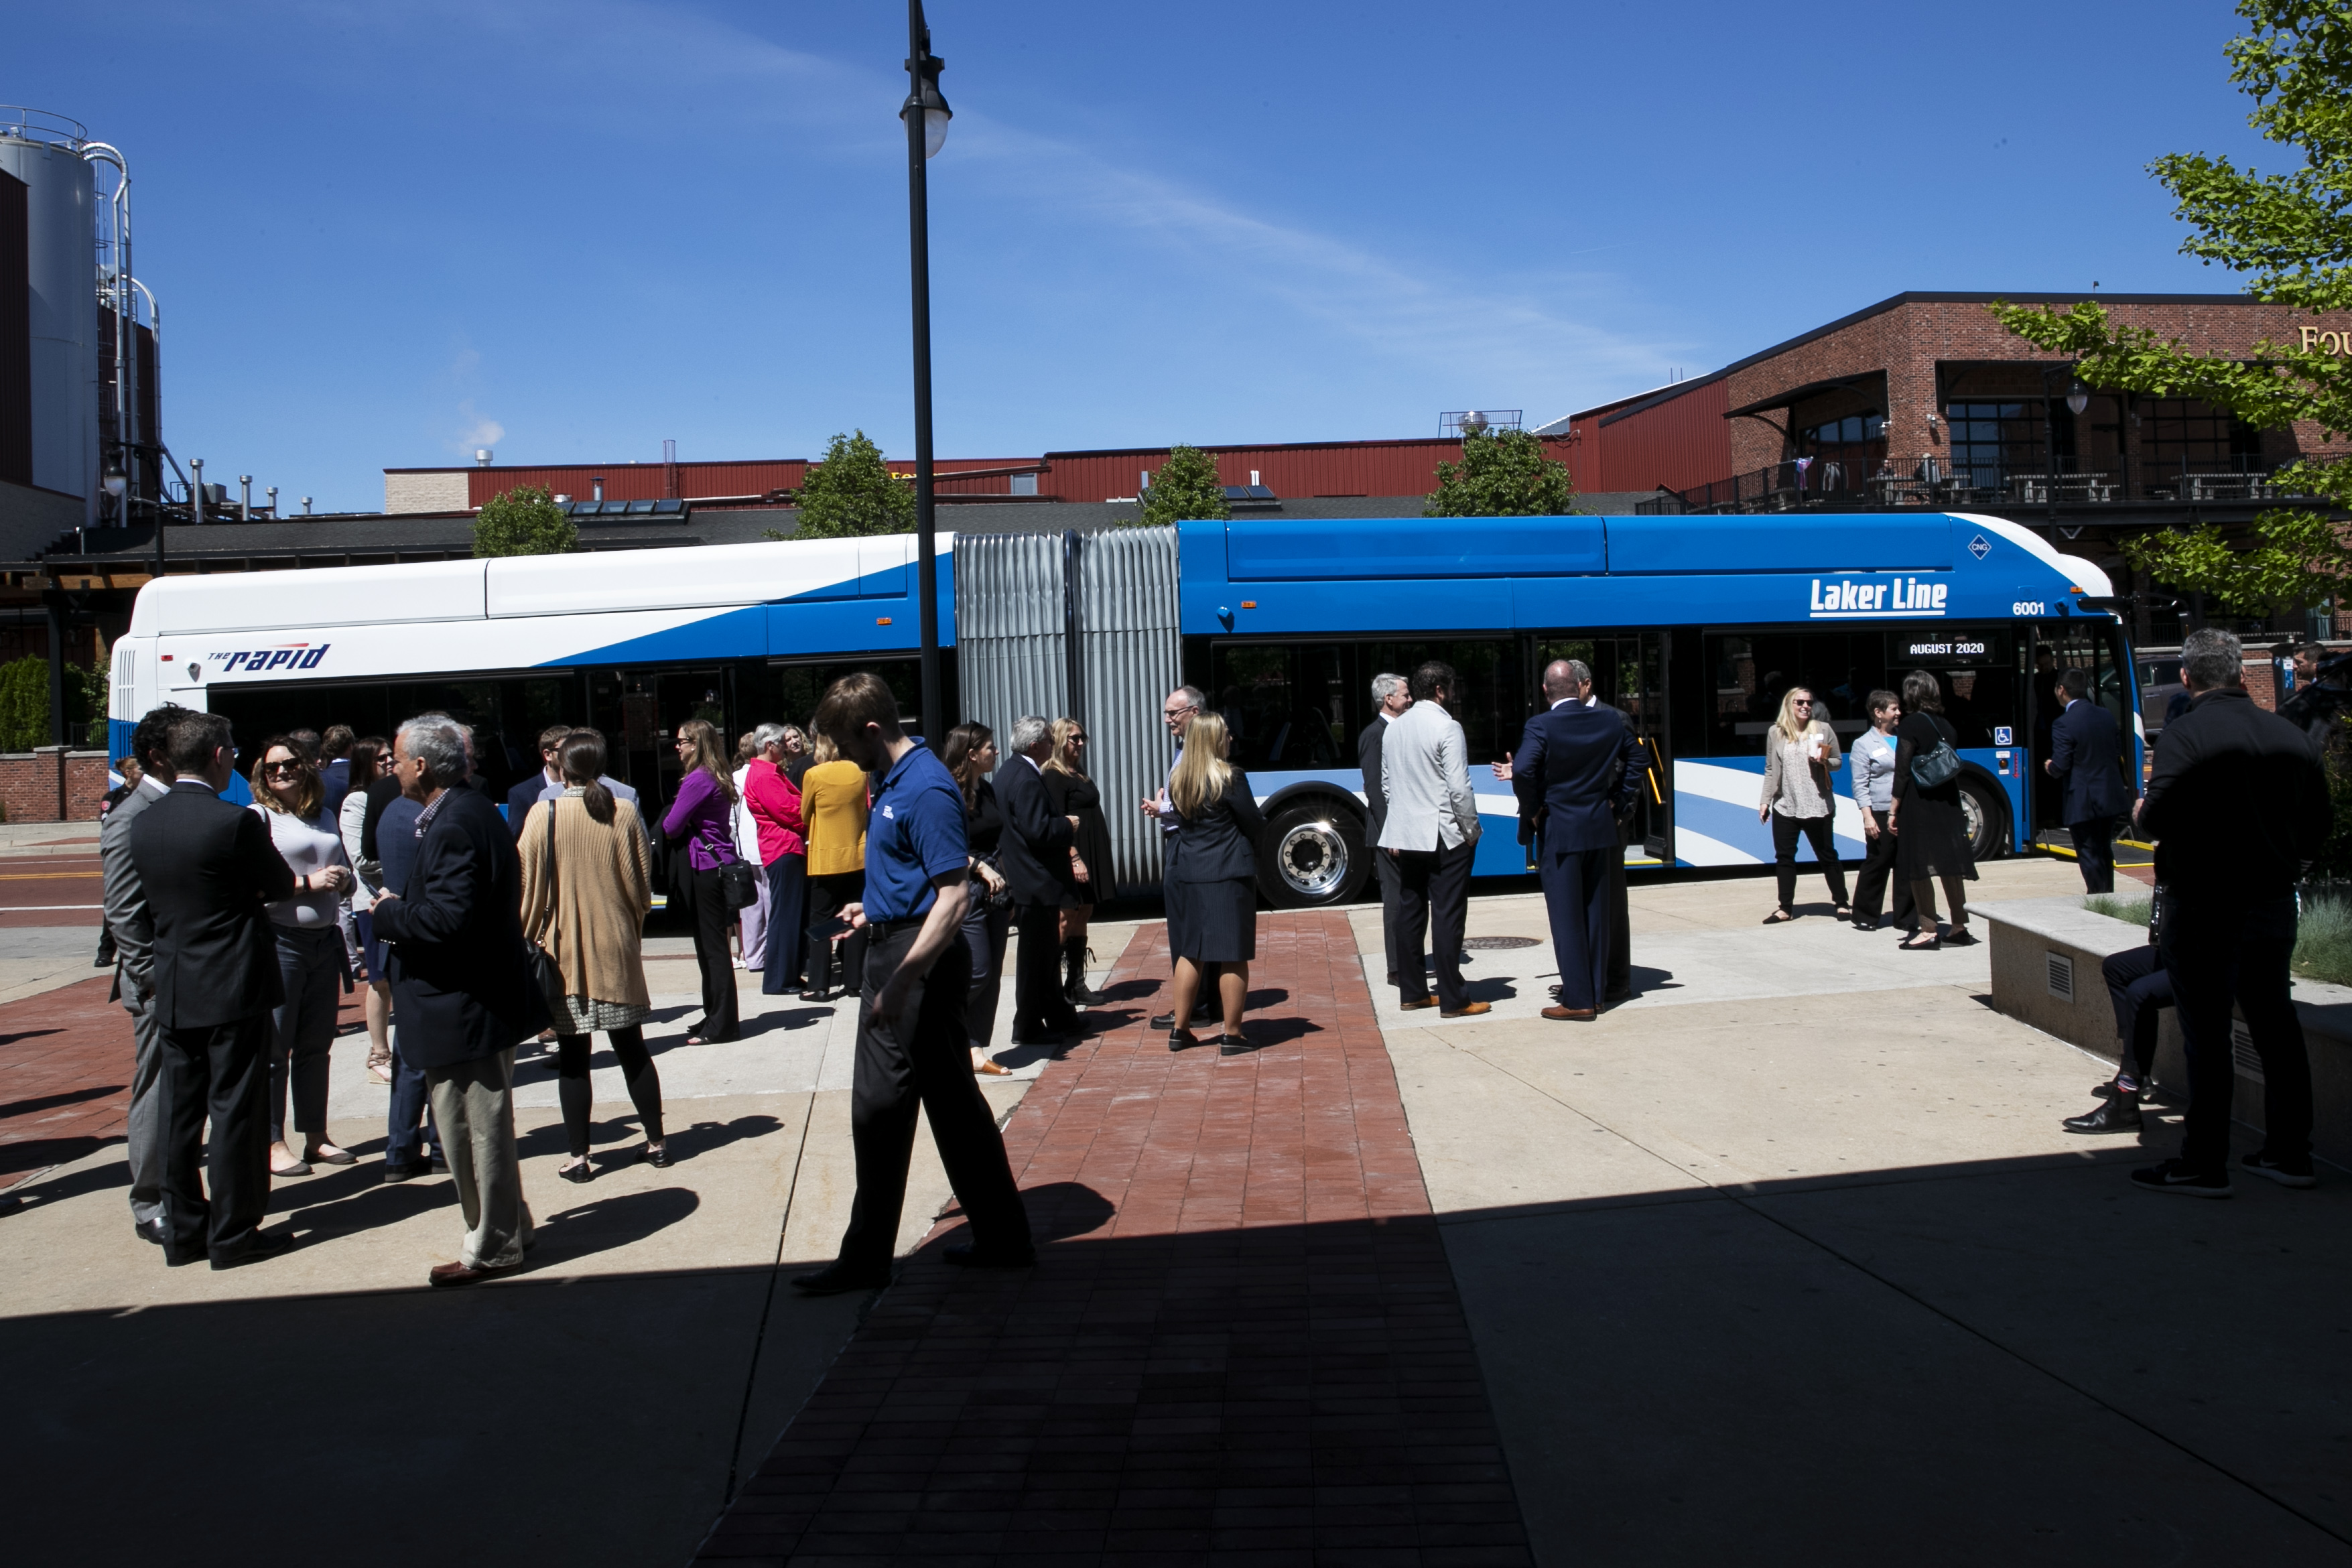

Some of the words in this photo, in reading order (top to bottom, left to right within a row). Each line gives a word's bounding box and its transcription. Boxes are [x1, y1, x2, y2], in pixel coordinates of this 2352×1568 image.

[1811, 579, 1888, 610] Laker
[1892, 578, 1948, 609] Line
[2012, 602, 2044, 616] 6001
[1910, 644, 1953, 654] AUGUST
[1956, 643, 1985, 653] 2020
